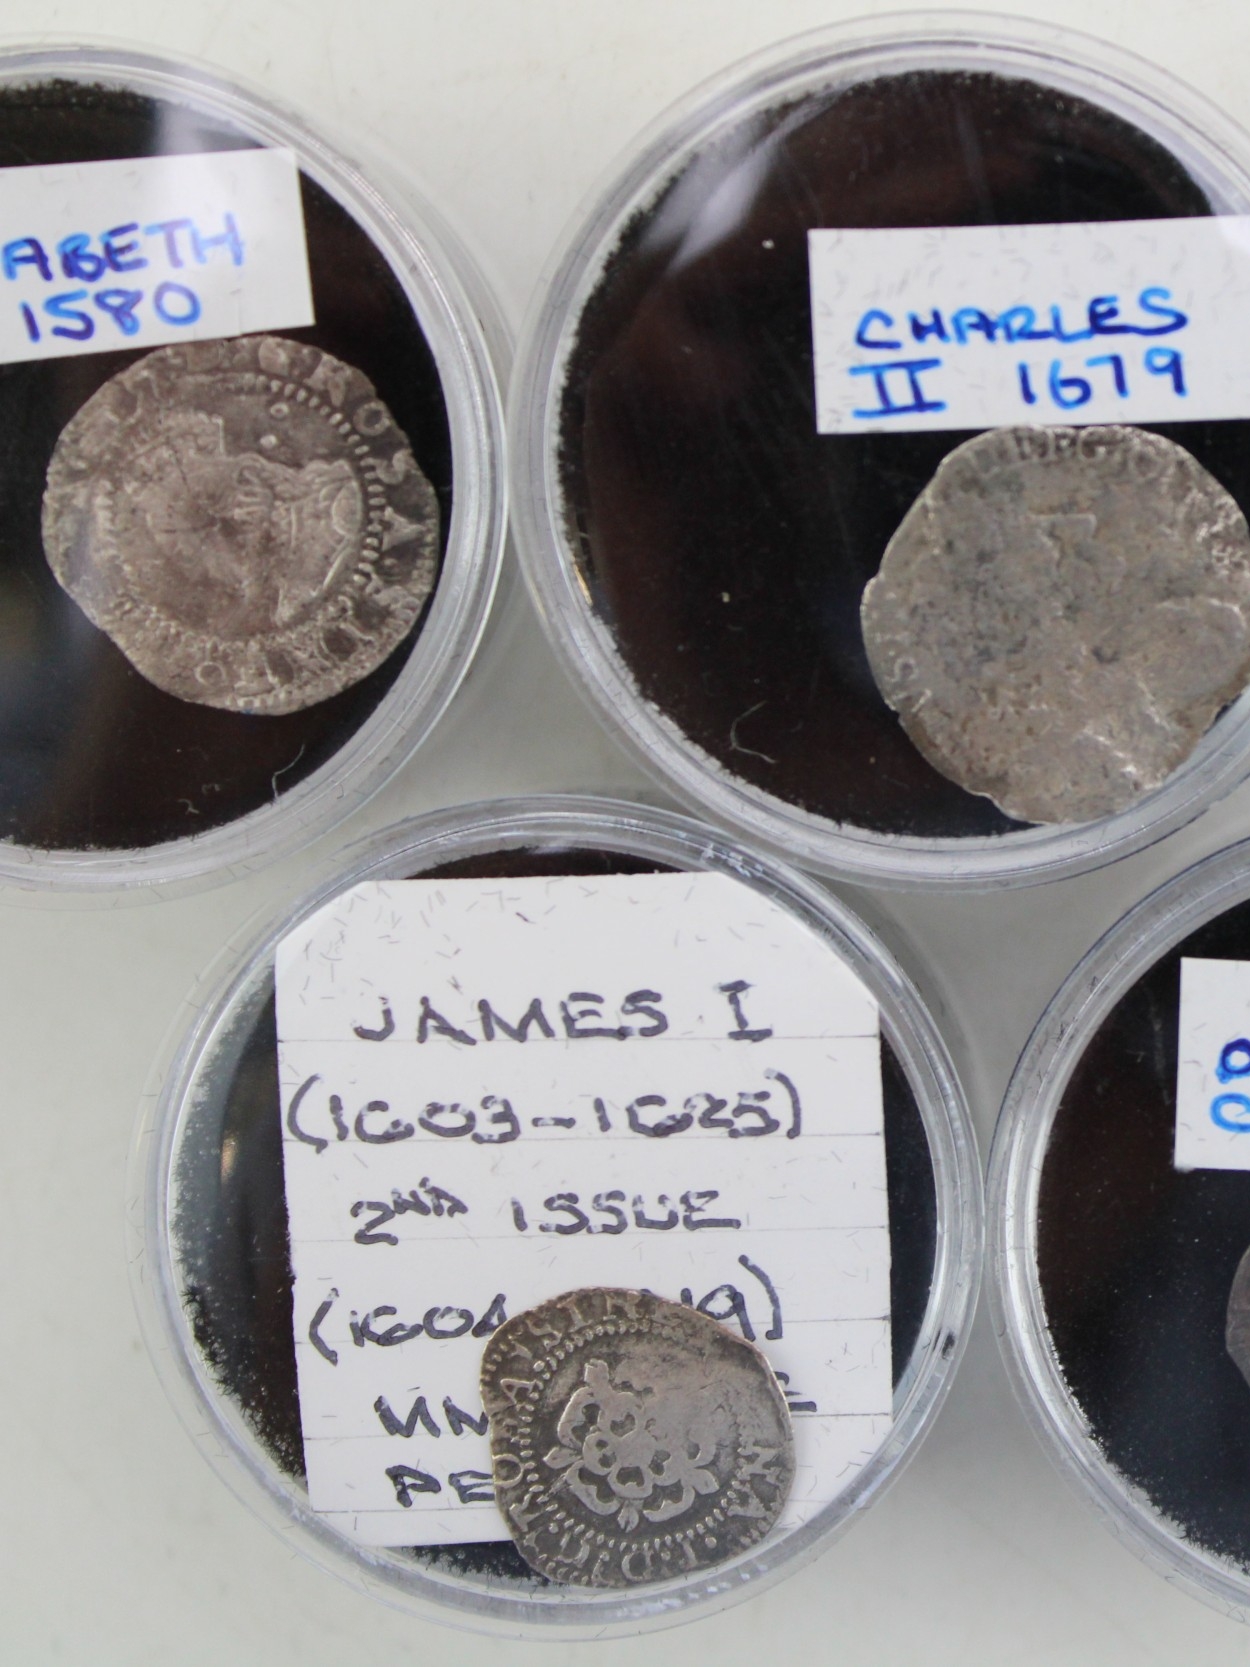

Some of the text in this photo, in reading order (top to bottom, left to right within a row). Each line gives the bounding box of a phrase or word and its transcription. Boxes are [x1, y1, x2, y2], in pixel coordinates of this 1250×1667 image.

[19, 282, 202, 343] 1580
[854, 288, 1189, 350] CHARLES
[848, 347, 1187, 419] II 1679
[354, 979, 773, 1044] JAMES I
[512, 1190, 741, 1236] ISSUE
